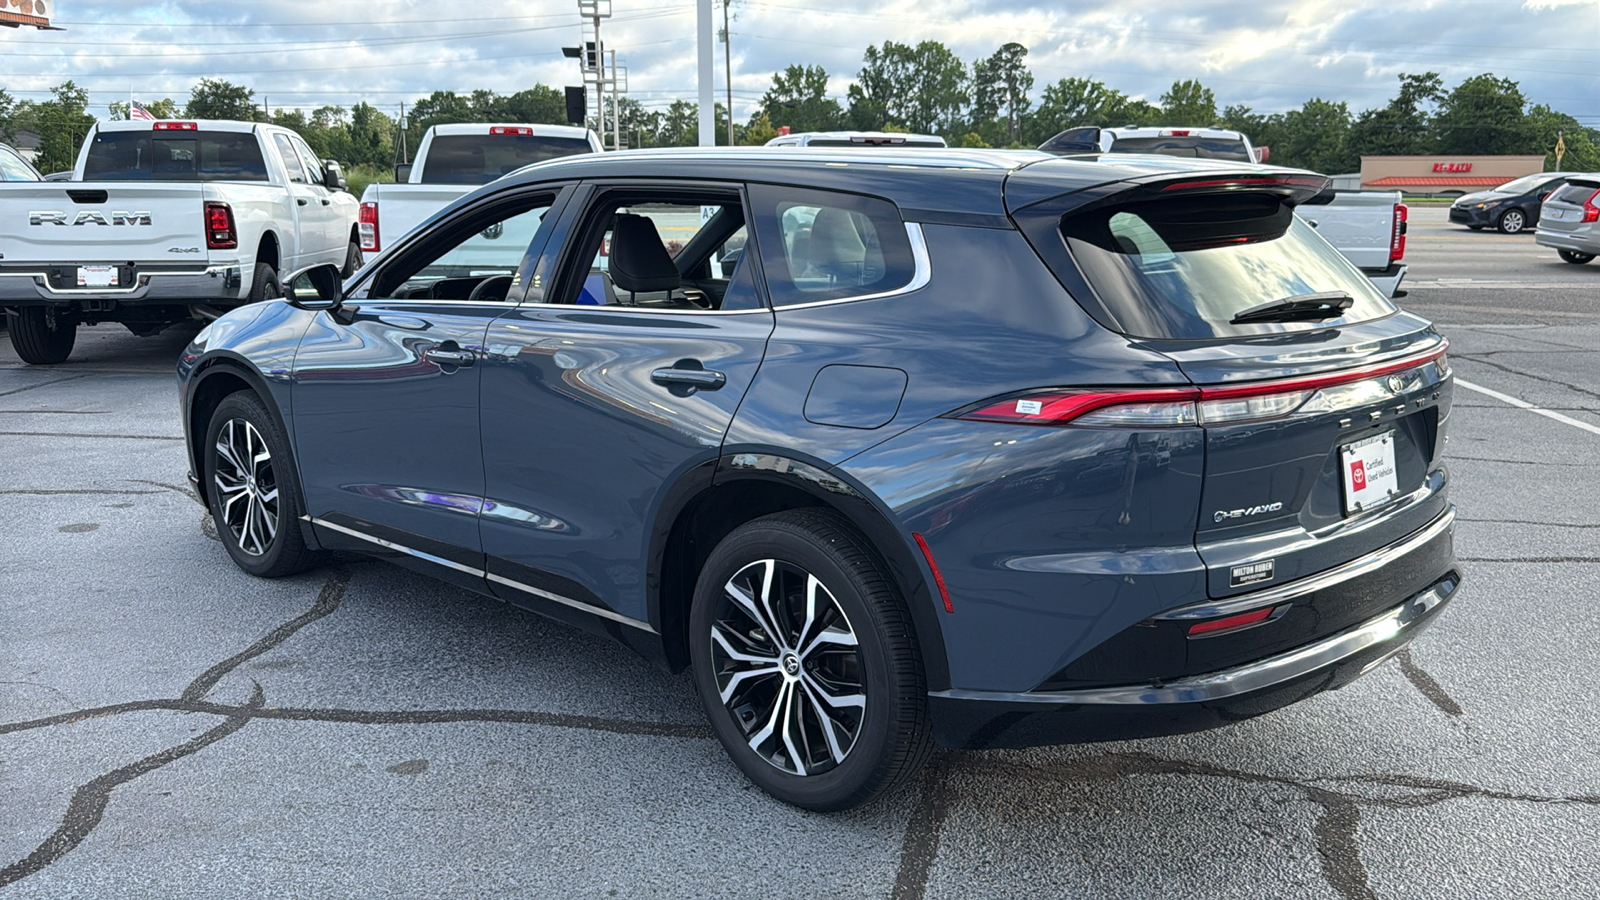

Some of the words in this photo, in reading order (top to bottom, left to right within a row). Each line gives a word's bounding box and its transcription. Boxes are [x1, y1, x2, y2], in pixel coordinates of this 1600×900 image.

[28, 210, 152, 226] RAM
[1365, 457, 1384, 471] Certified
[1367, 472, 1379, 483] Used
[1378, 466, 1394, 480] Vehicles
[1233, 565, 1254, 577] MILTON
